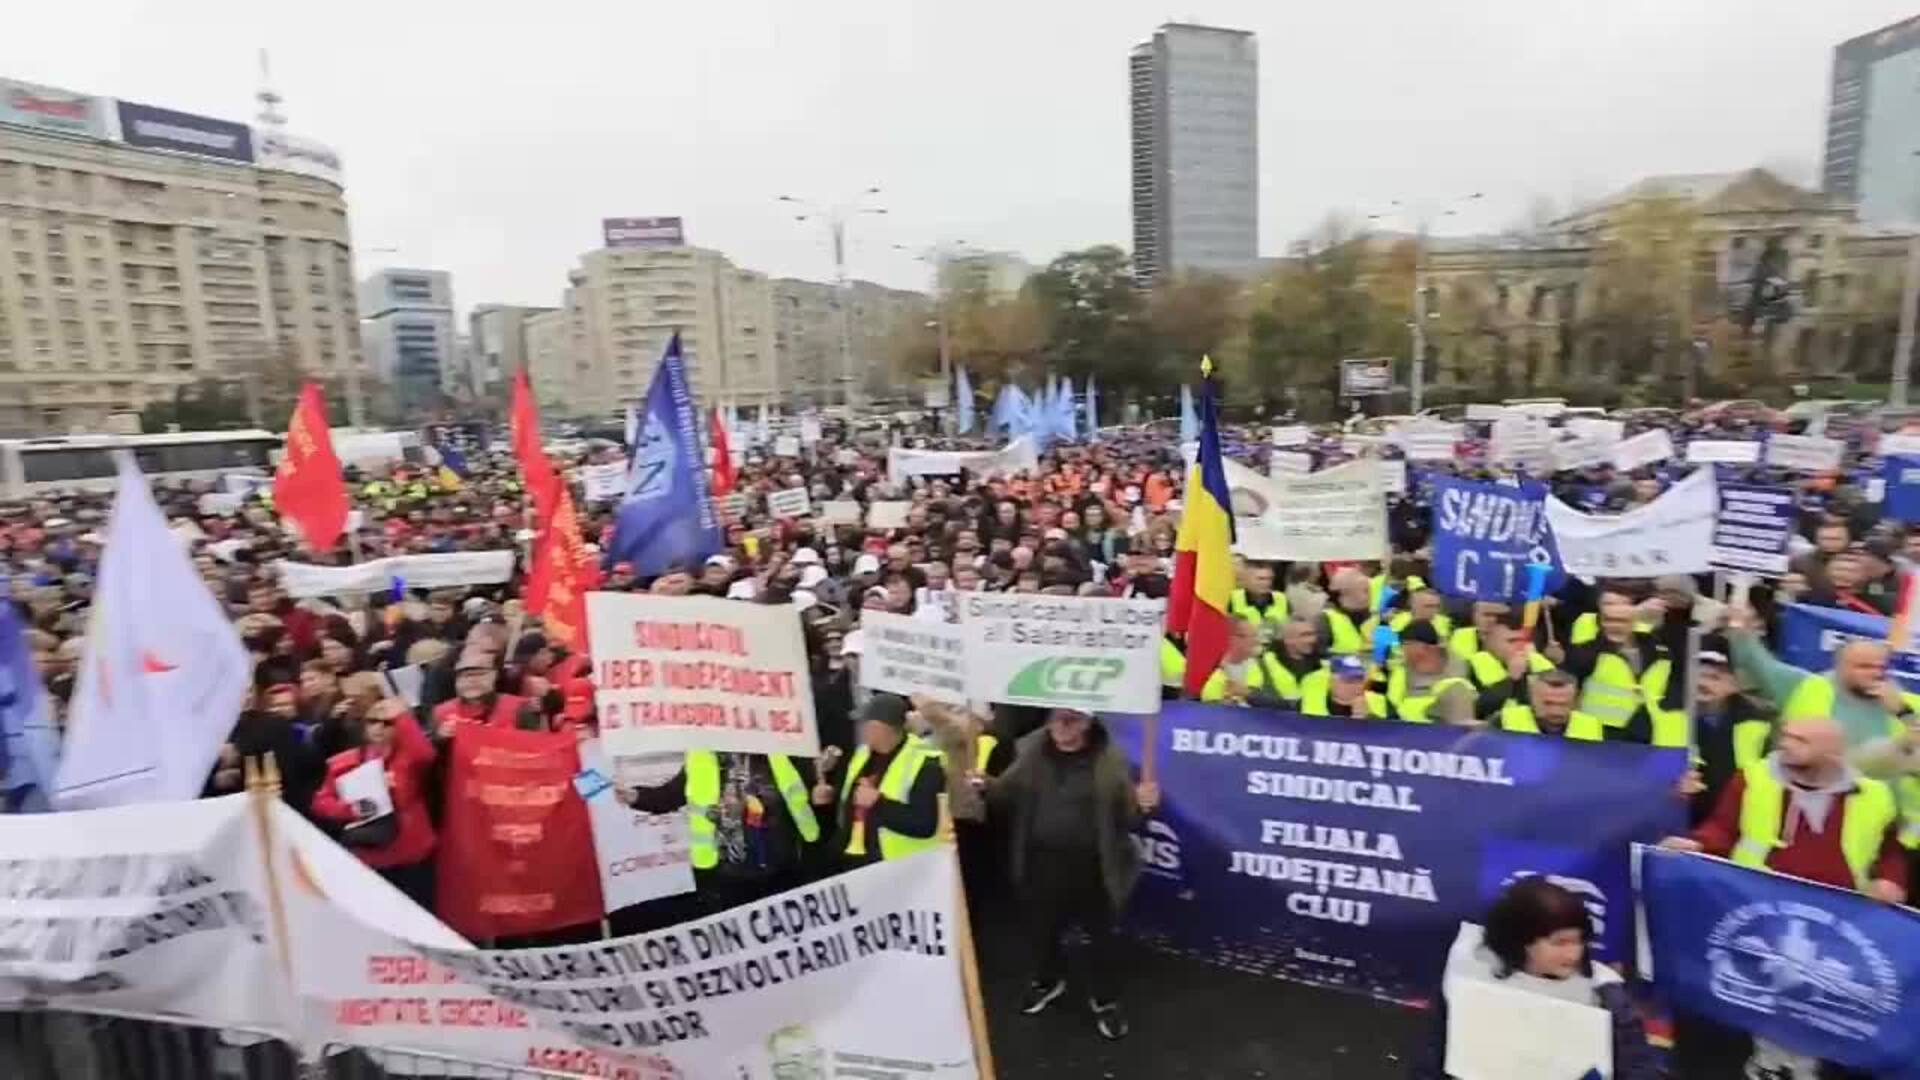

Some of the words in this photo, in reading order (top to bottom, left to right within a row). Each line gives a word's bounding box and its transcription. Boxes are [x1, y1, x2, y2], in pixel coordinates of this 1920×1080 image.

[599, 658, 659, 692] IBER
[1172, 728, 1309, 764] BLOCUL
[1314, 740, 1514, 786] NAȚIONAL
[1247, 770, 1422, 813] SINDICAL
[1261, 818, 1403, 861] FILIALA
[1228, 848, 1439, 902] JUDEȚEANĂ
[688, 917, 744, 959] DIN
[749, 882, 860, 945] CADRUL
[1286, 894, 1372, 927] CLUJ
